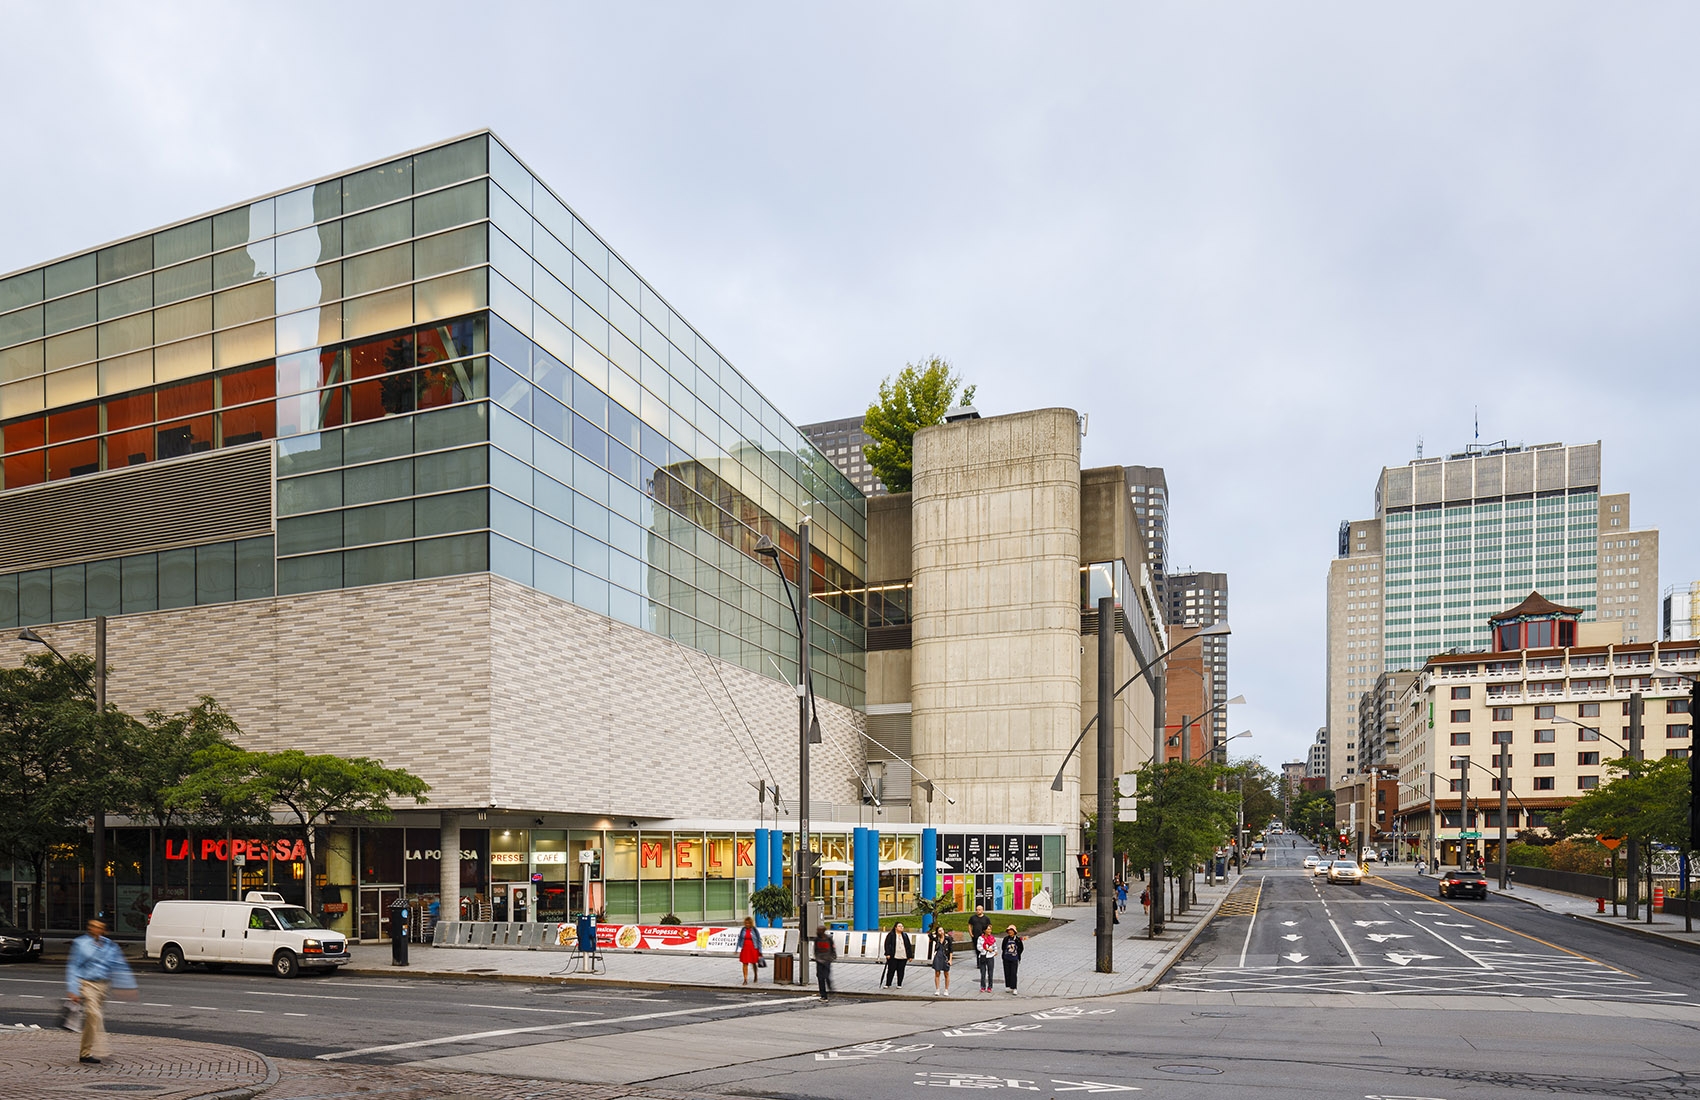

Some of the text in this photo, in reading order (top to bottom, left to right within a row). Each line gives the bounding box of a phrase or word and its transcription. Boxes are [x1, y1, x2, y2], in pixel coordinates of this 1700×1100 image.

[166, 839, 306, 861] LA POPESSA
[406, 849, 478, 860] LA POSSA
[641, 842, 753, 868] MELK
[491, 854, 524, 862] PRESSE
[537, 853, 559, 862] CAFÉ
